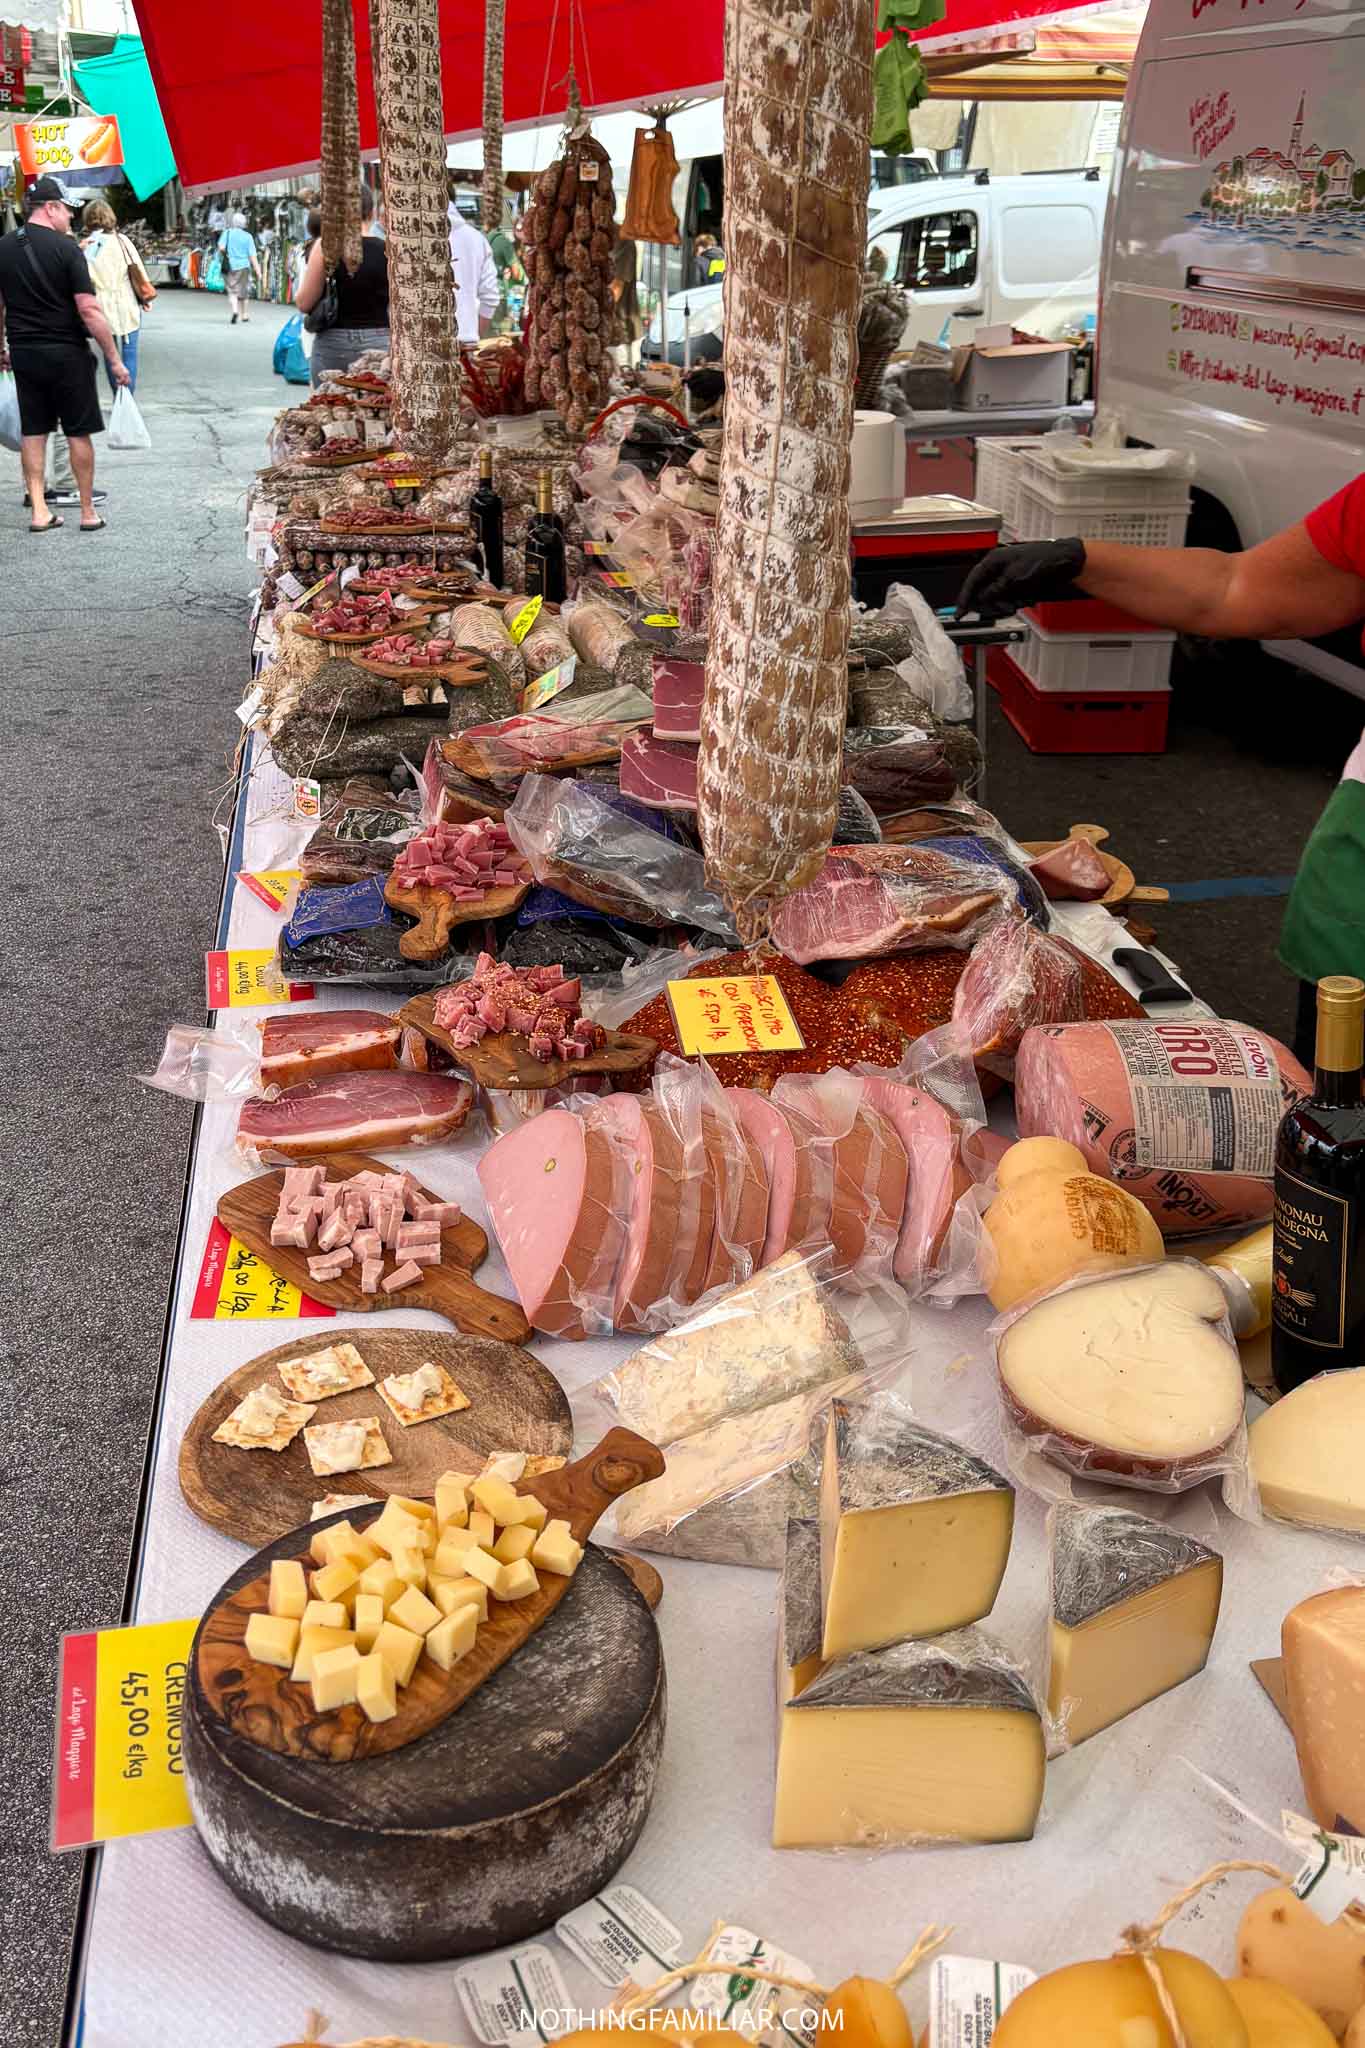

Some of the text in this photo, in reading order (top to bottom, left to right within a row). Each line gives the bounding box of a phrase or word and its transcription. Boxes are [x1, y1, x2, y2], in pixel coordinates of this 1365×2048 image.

[31, 122, 69, 143] HOT
[34, 146, 73, 168] DOG
[1154, 1025, 1219, 1076] ORO
[1209, 1036, 1232, 1077] PISTACCHIO
[1214, 1027, 1245, 1077] MORTADELLA
[1241, 1035, 1270, 1079] LEVONI
[1278, 1198, 1323, 1227] NONAU
[67, 1698, 88, 1726] Lago
[120, 1671, 149, 1780] 45,00 €/kg
[65, 1726, 87, 1782] Maggiore
[983, 1996, 992, 2048] 08/2025
